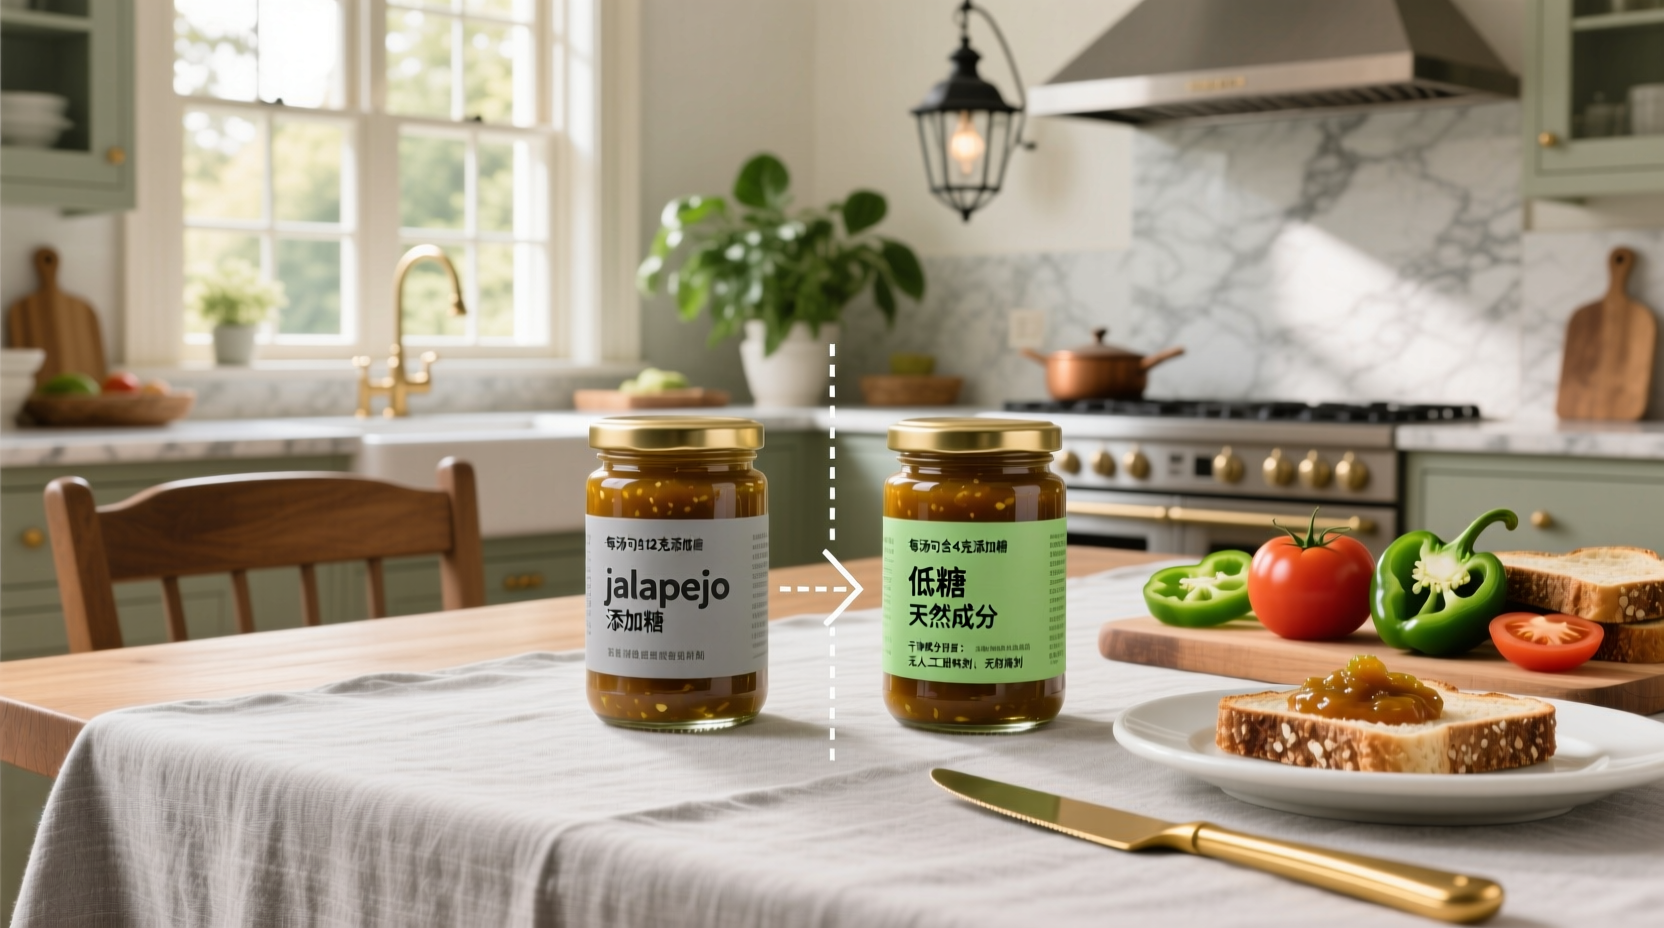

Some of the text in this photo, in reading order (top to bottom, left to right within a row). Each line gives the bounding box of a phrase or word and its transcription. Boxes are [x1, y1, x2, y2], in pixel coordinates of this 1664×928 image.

[604, 568, 729, 609] jalapejo
[908, 566, 966, 599] 低糖
[606, 610, 663, 633] 添加糖
[909, 603, 998, 630] 天然成分
